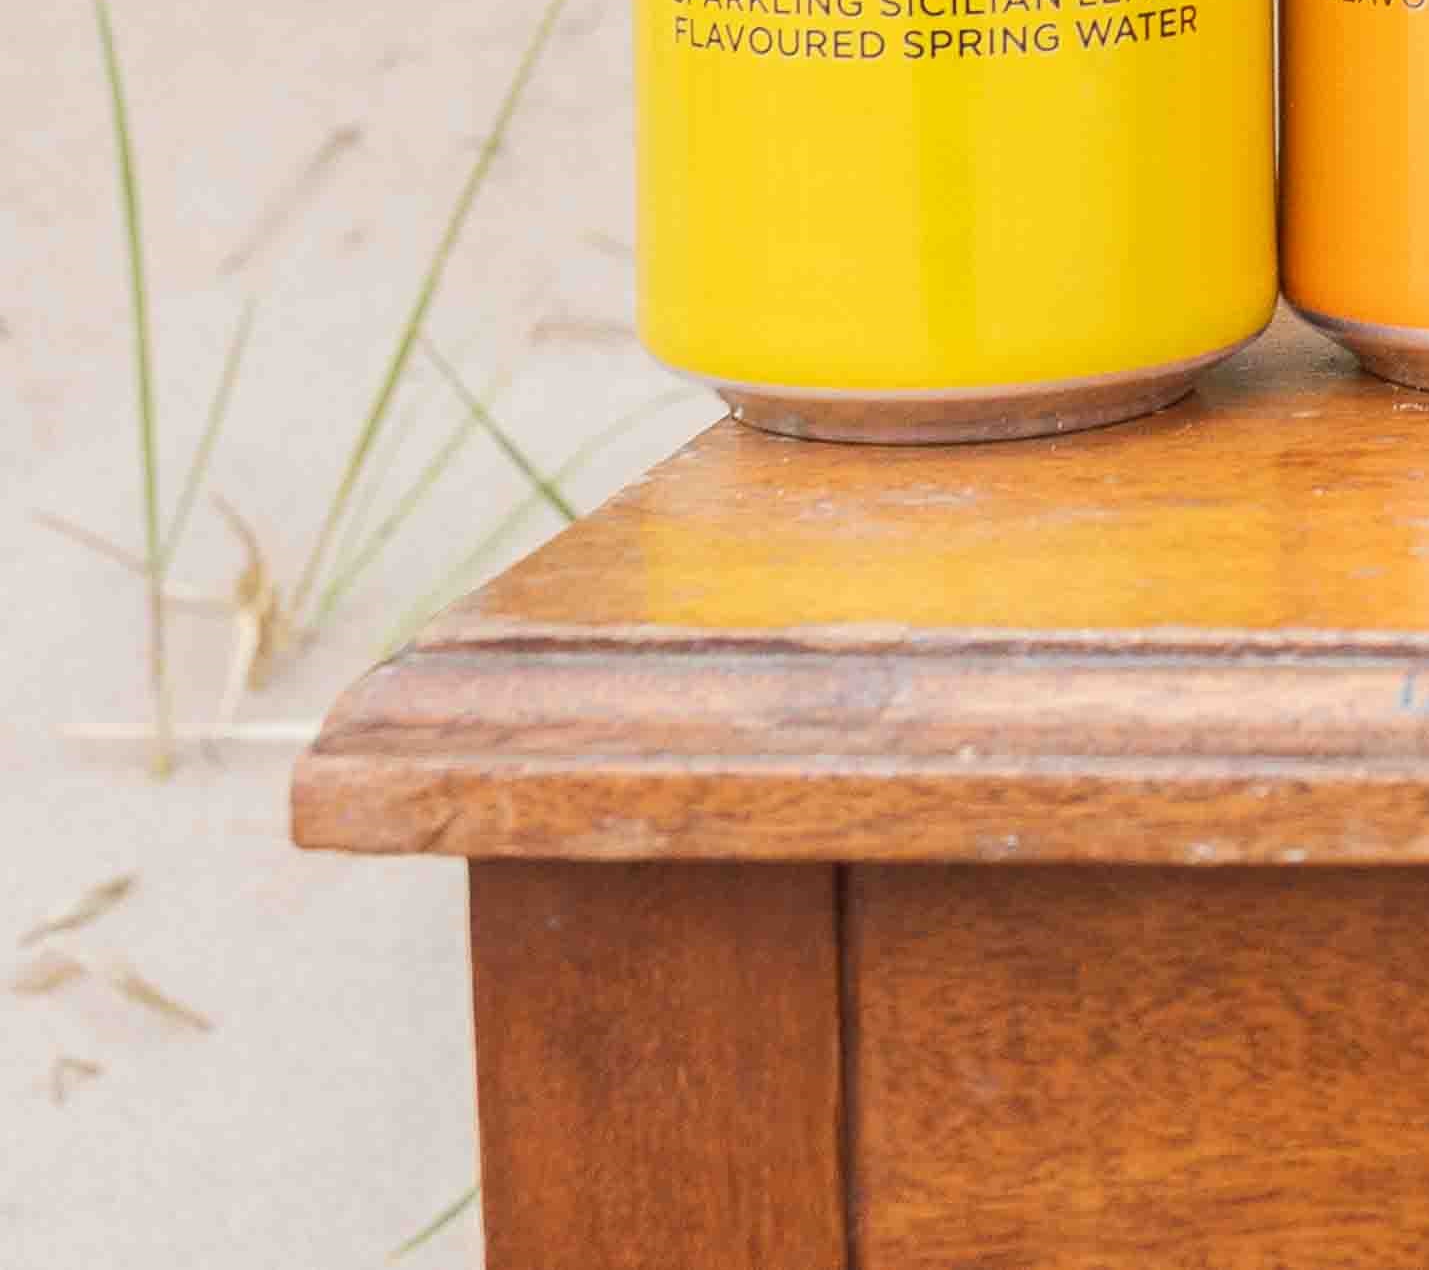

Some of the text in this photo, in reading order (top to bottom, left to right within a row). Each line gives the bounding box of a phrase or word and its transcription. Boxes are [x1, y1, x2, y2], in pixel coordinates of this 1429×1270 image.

[673, 5, 1198, 60] FLAVOURED SPRING WATER
